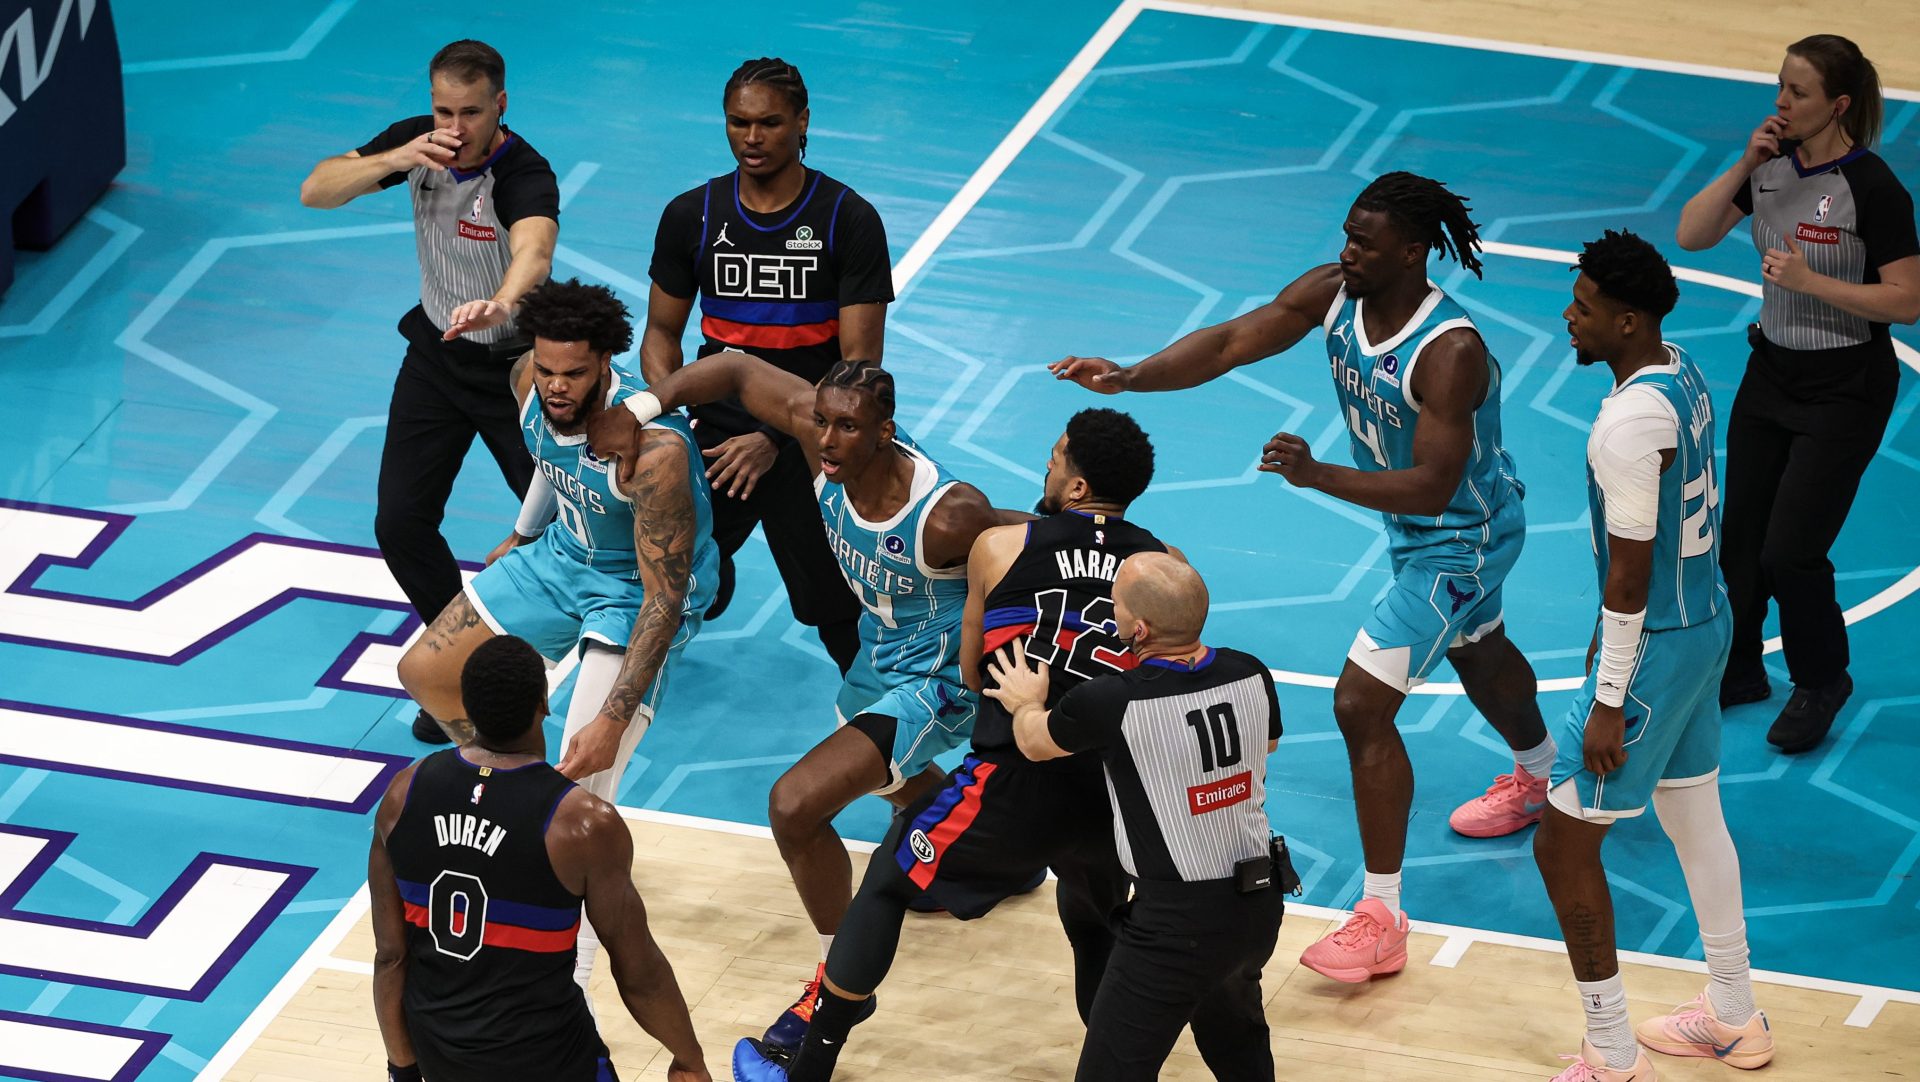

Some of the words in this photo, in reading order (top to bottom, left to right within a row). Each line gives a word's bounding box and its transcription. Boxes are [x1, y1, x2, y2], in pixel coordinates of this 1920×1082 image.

[460, 223, 495, 238] Emirates
[787, 241, 821, 249] StockX
[1797, 226, 1838, 240] Emirates
[714, 253, 818, 299] DET
[1349, 405, 1387, 467] 4
[555, 488, 589, 548] 0
[824, 521, 914, 594] ORNETS
[1024, 588, 1130, 680] 12
[1186, 702, 1241, 773] 10
[1195, 781, 1247, 807] Emirates
[434, 813, 507, 857] DUREN
[914, 834, 931, 856] DET
[429, 870, 488, 960] 0
